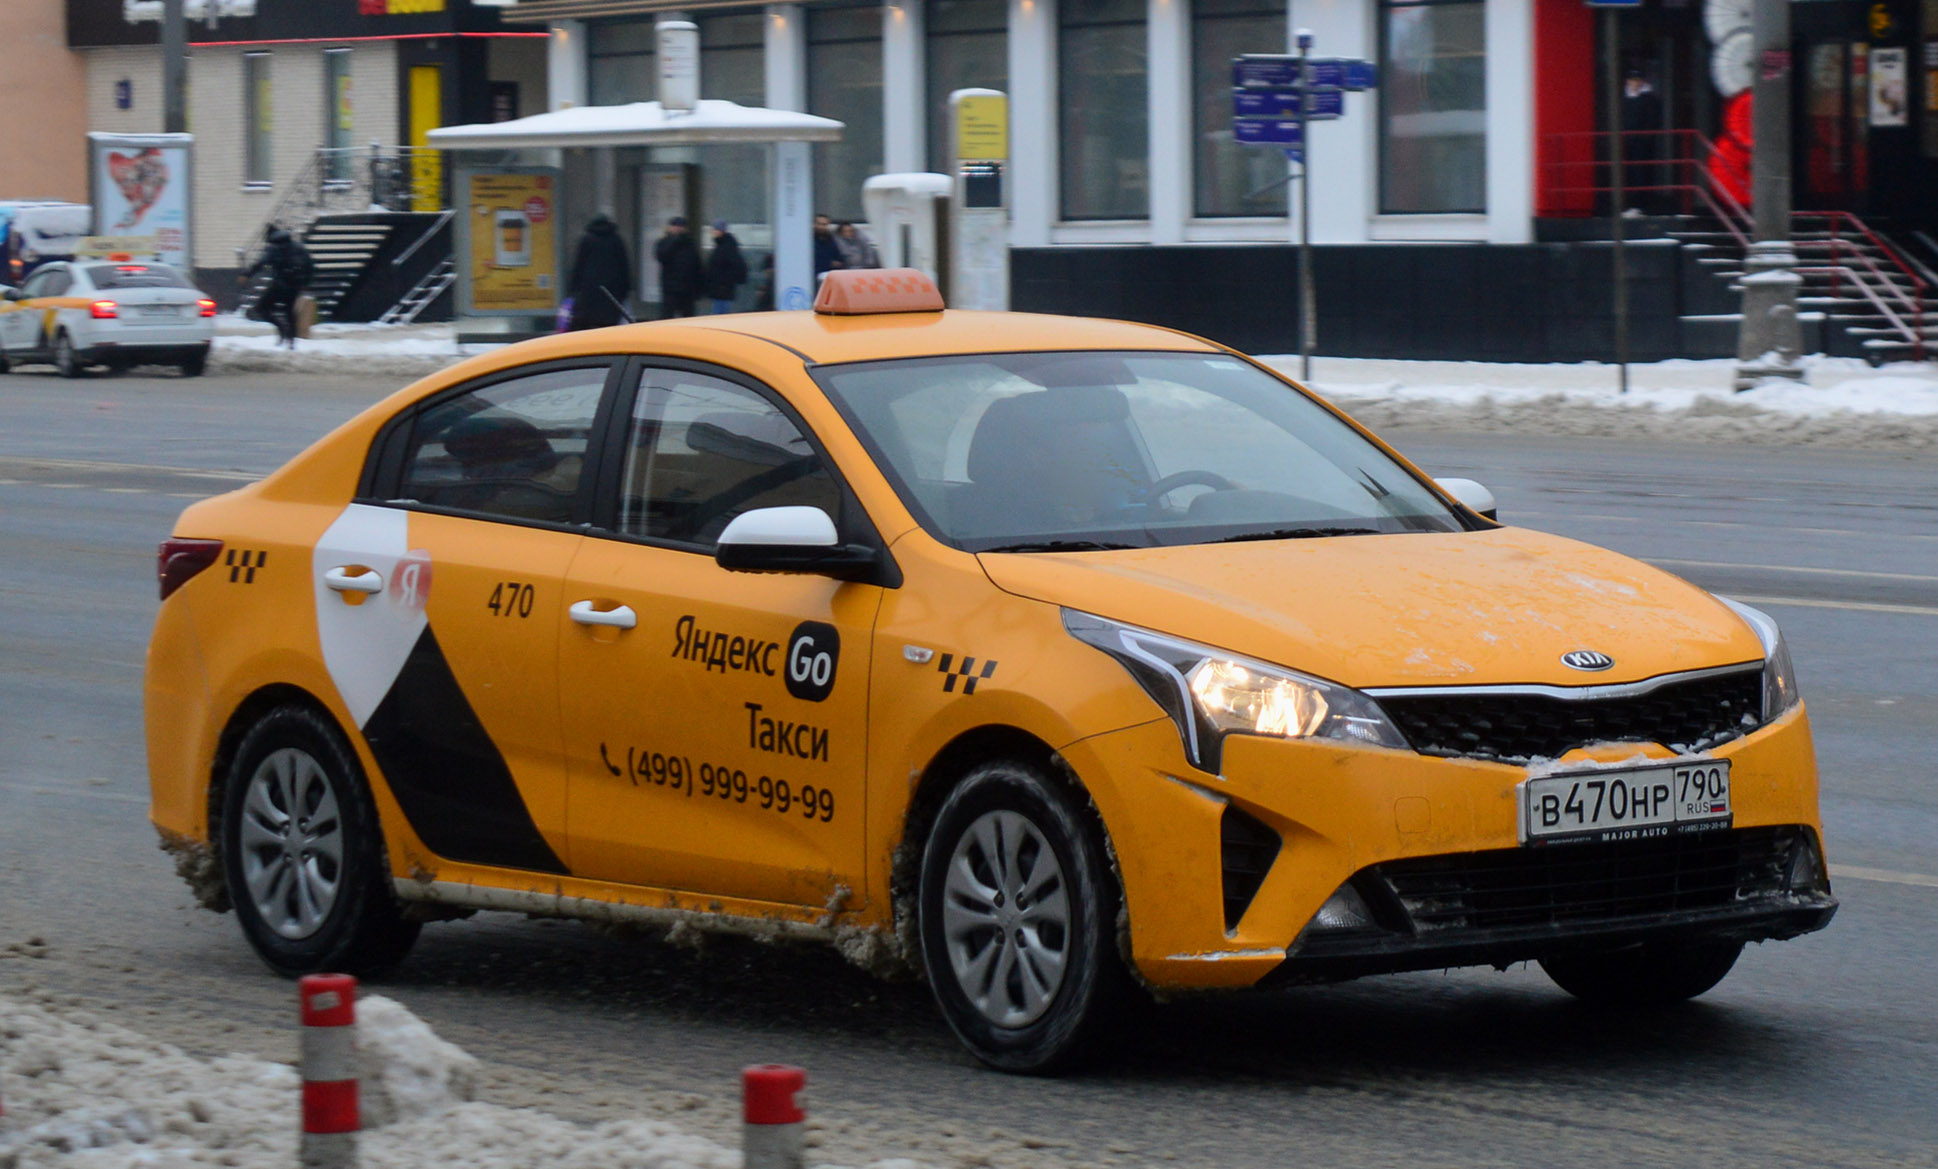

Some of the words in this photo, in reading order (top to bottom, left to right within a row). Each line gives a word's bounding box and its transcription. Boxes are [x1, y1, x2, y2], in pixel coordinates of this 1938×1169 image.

[401, 563, 421, 607] Я
[488, 582, 535, 619] 470
[671, 615, 780, 677] Яндекс
[790, 635, 832, 687] Go
[1566, 651, 1611, 667] KIA
[744, 702, 829, 763] Такси
[628, 746, 693, 798] (499)
[700, 763, 835, 823] 999-99-99
[1676, 767, 1722, 803] 790
[1687, 802, 1710, 815] RUS
[1602, 830, 1638, 841] MAJOR
[1642, 827, 1668, 838] AUTO
